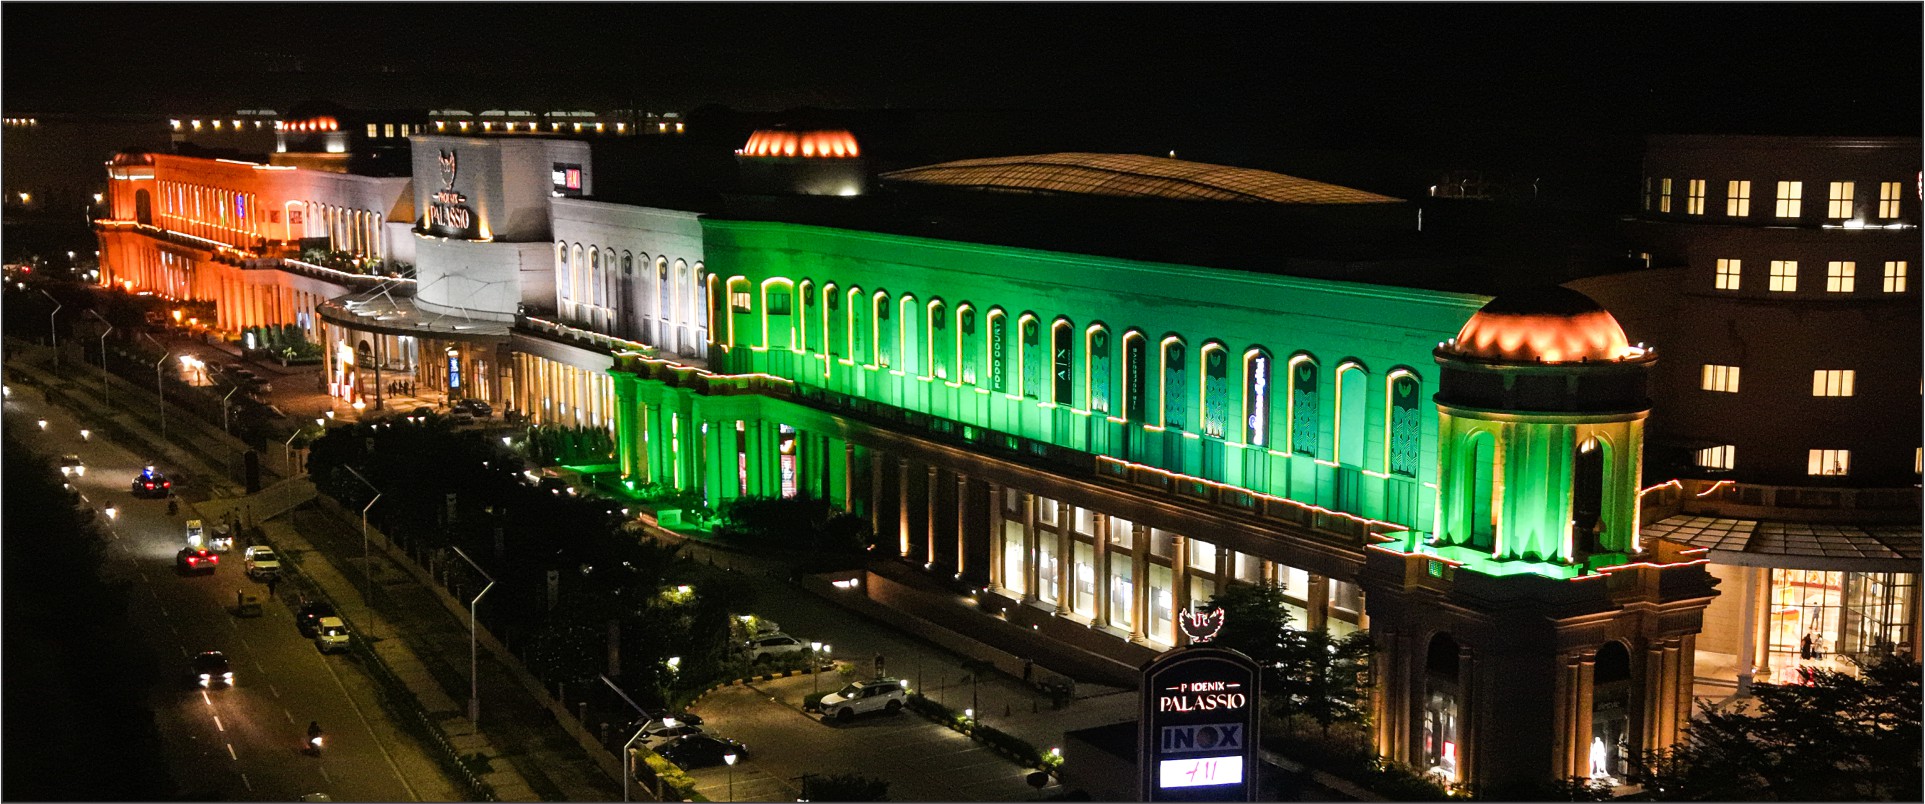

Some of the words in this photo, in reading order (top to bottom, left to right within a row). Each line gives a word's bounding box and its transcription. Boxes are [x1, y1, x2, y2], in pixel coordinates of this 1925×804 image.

[430, 205, 470, 229] PALASSIO
[1160, 693, 1245, 712] PALASSIO
[1163, 726, 1239, 749] INOX
